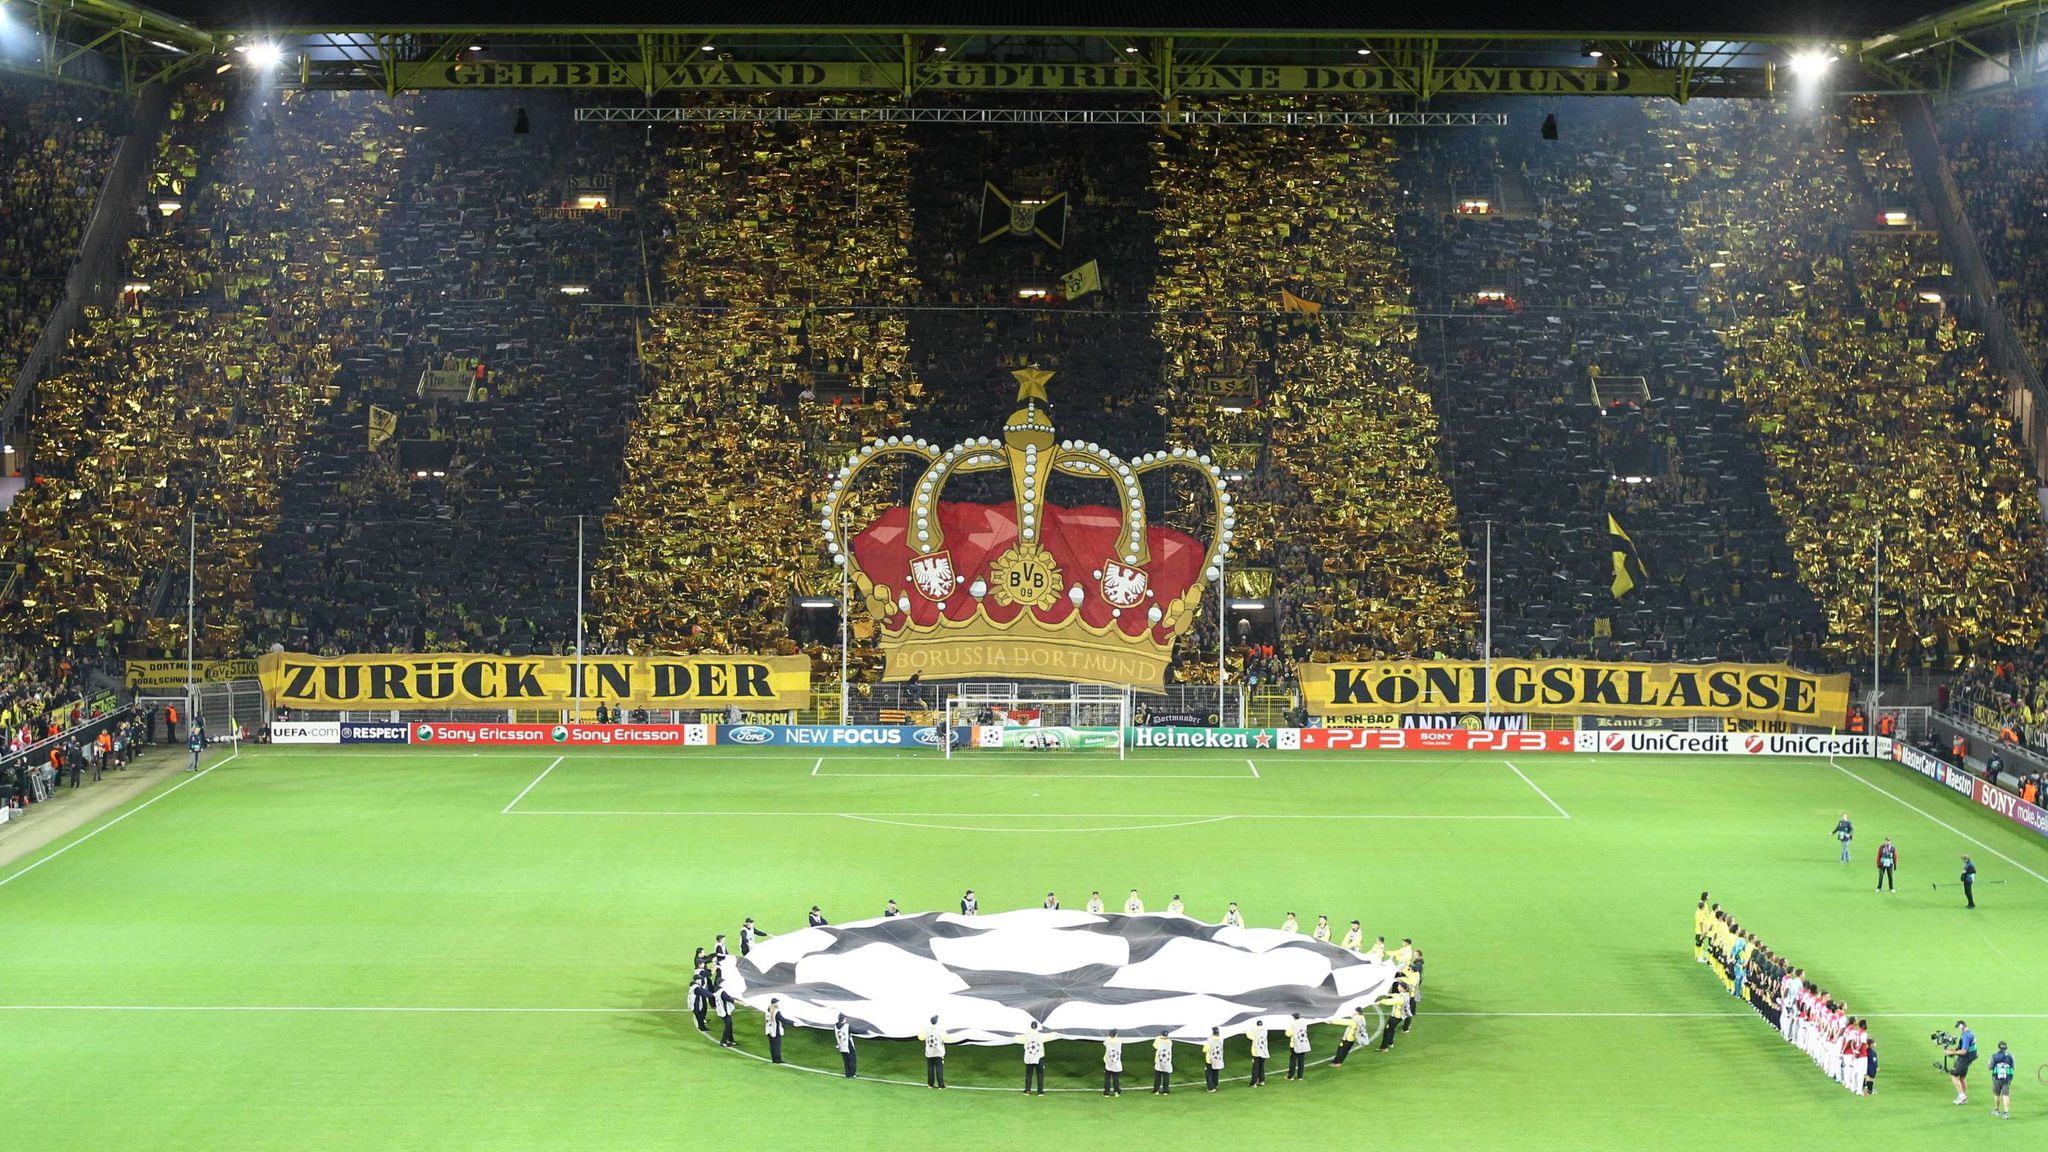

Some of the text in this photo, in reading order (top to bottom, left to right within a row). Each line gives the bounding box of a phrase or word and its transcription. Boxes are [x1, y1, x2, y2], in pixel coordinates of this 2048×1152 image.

[444, 63, 628, 86] GELBE
[661, 63, 827, 86] WAND
[1303, 67, 1631, 92] DORTMUND
[1010, 562, 1044, 588] BVB
[1020, 587, 1033, 598] 09
[896, 646, 1157, 682] BORUSSIA DORTMUND
[282, 661, 776, 700] ZURÜCK IN DER
[1329, 665, 1817, 714] KÖNIGSKLASSE
[352, 727, 408, 739] RESPECT
[437, 727, 544, 742] Sony Ericsson
[572, 728, 680, 743] Sony Ericsson
[737, 728, 766, 741] Ford
[785, 728, 902, 744] NEW FOCUS
[1136, 728, 1248, 748] Heineken
[1327, 729, 1406, 749] PS3
[1420, 732, 1454, 741] SONY
[1467, 731, 1546, 750] PS3
[1631, 733, 1729, 751] UniCredit
[1769, 735, 1870, 755] UniCredit
[1902, 746, 1937, 778] MasterCard
[1945, 767, 1971, 795] Maestro
[1981, 783, 2017, 818] SONY
